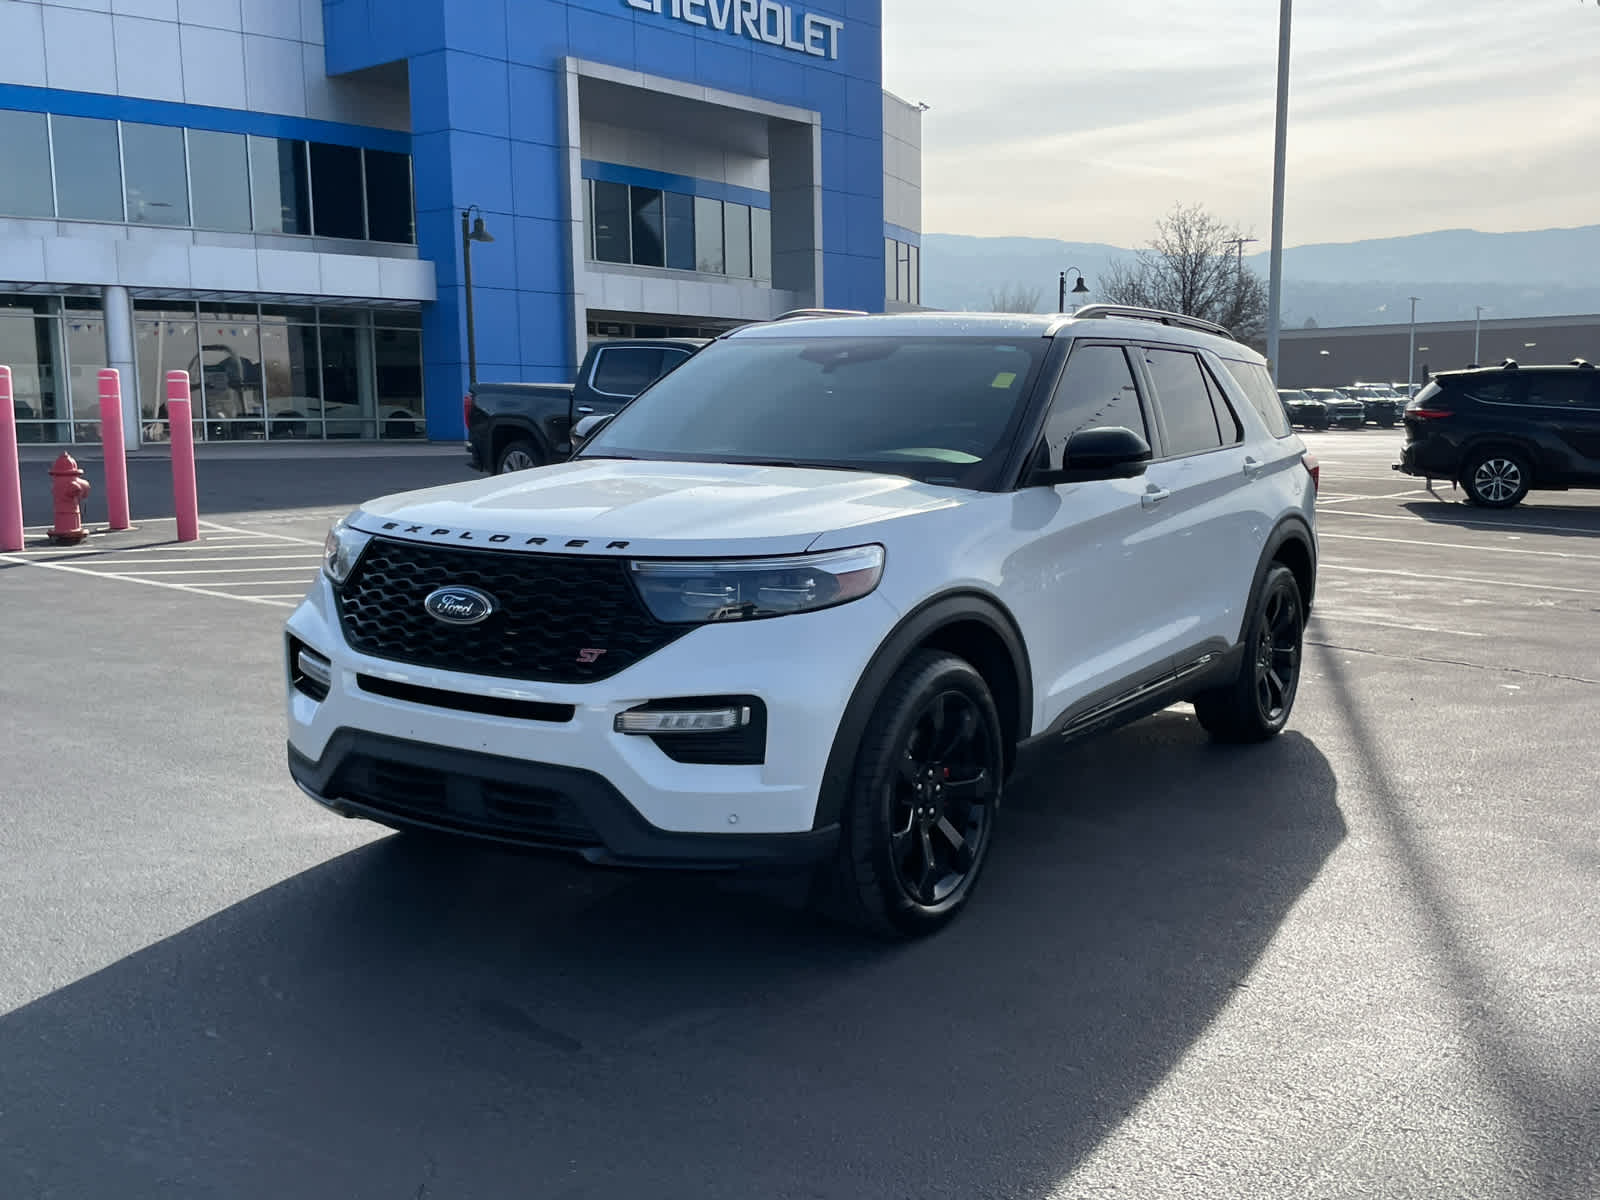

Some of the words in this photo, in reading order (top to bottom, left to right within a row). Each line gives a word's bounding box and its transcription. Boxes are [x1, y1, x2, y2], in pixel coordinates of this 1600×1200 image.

[627, 0, 844, 60] EVROLET
[382, 522, 630, 549] EXPLORER
[437, 594, 474, 616] Ford
[576, 648, 607, 663] ST
